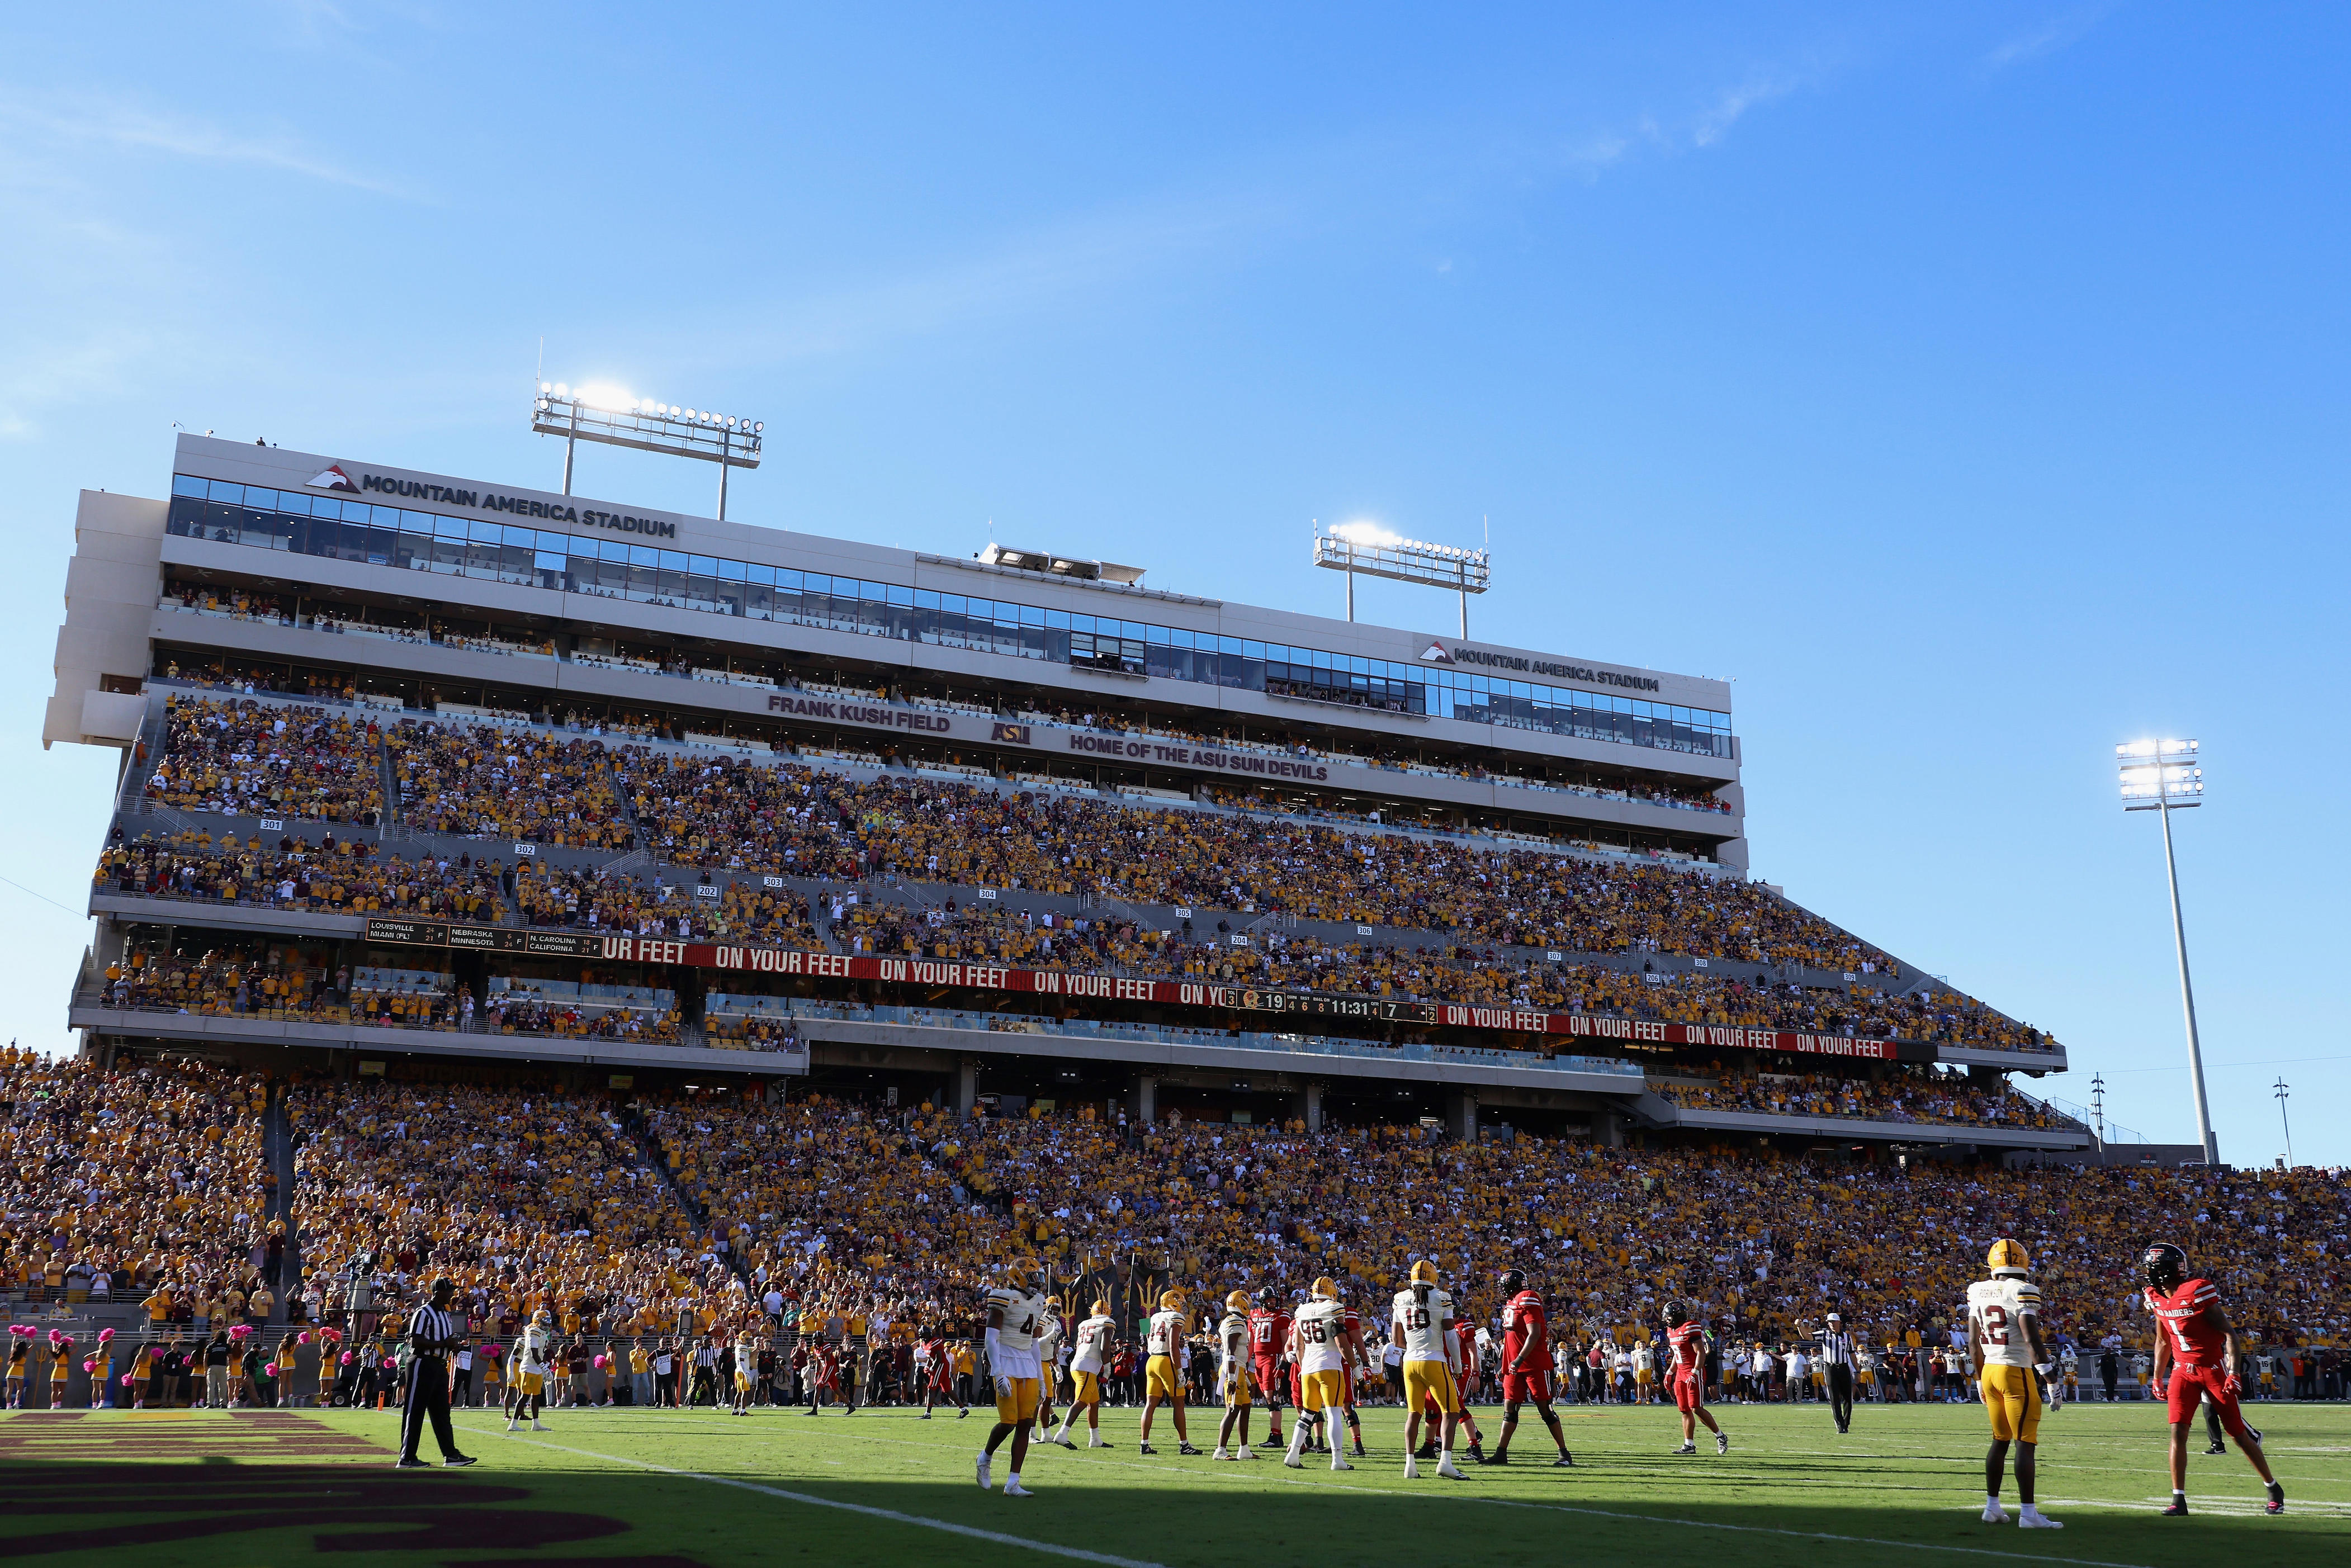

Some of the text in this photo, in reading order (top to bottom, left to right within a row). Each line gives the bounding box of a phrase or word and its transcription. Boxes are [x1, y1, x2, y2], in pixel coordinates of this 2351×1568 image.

[363, 474, 675, 539] MOUNTAIN AMERICA STADIUM
[1455, 648, 1659, 692] MOUNTAIN AMERICA STADIUM
[287, 704, 325, 718] JAKE
[769, 695, 950, 732] FRANK KUSH FIELD
[991, 722, 1030, 745] ASU
[625, 743, 651, 755] PAT
[1070, 735, 1327, 780] HOME OF THE ASU SUN DEVILS
[263, 820, 280, 829] 301
[517, 845, 533, 854] 302
[700, 887, 715, 896] 202
[371, 922, 414, 932] LOUISVILLE
[452, 929, 493, 938] NEBRASKA
[451, 937, 494, 946] MINNESOTA
[529, 943, 573, 952] CALIFORNIA
[540, 936, 576, 944] CAROLINA
[638, 941, 687, 964] FEET
[715, 946, 853, 977] ON YOUR FEET
[879, 959, 1009, 989] ON YOUR FEET
[1034, 972, 1156, 1000] ON YOUR FEET
[1180, 984, 1203, 1005] ON
[1228, 995, 1235, 1005] 3
[1266, 994, 1283, 1008] 19
[1288, 1001, 1324, 1012] 4 6 8
[1332, 999, 1368, 1015] 11:31
[1387, 1003, 1397, 1018] 7
[1428, 1011, 1435, 1021] 2
[1447, 1006, 1549, 1031] ON YOUR FEET
[1570, 1016, 1667, 1041] ON YOUR FEET
[1686, 1025, 1778, 1049] ON YOUR FEET
[1796, 1034, 1885, 1058] ON YOUR FEET
[2003, 1256, 2019, 1267] 12
[308, 1297, 317, 1306] 25
[475, 1295, 484, 1303] 16
[1980, 1288, 2004, 1298] ROBINSON
[1406, 1308, 1430, 1330] 10
[1503, 1308, 1514, 1327] 9
[2164, 1308, 2194, 1317] RAIDERS
[471, 1321, 482, 1333] 42
[946, 1324, 955, 1333] 85
[1020, 1313, 1034, 1334] 4
[1151, 1321, 1167, 1342] 14
[1253, 1321, 1272, 1343] 70
[1301, 1318, 1327, 1344] 96
[1978, 1305, 2009, 1345] 12
[2168, 1319, 2192, 1352] 1
[1671, 1344, 1683, 1364] 8
